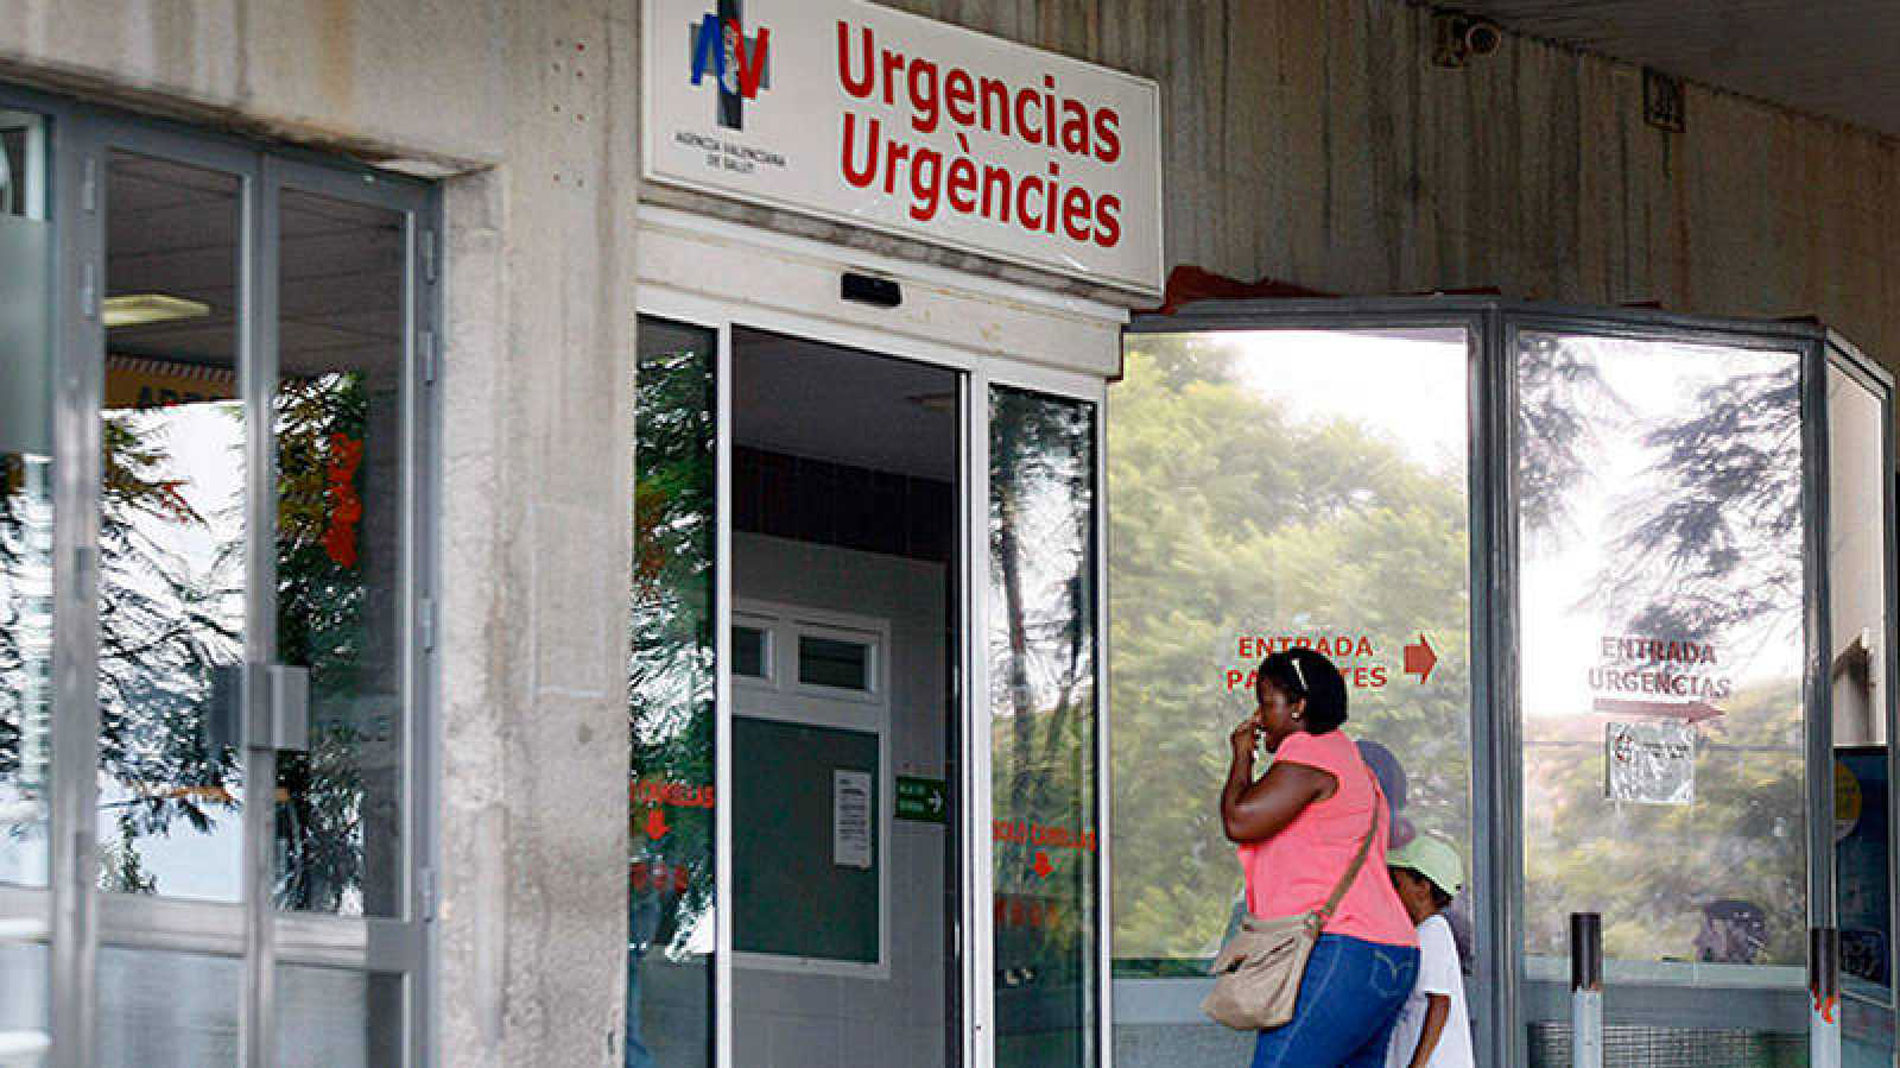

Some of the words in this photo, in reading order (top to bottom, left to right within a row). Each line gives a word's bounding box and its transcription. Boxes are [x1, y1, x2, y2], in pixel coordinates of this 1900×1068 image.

[837, 19, 1121, 163] Urgencias
[841, 111, 1121, 248] Urgències
[1588, 667, 1731, 698] URGENCIAS
[1602, 636, 1718, 664] ENTRADA
